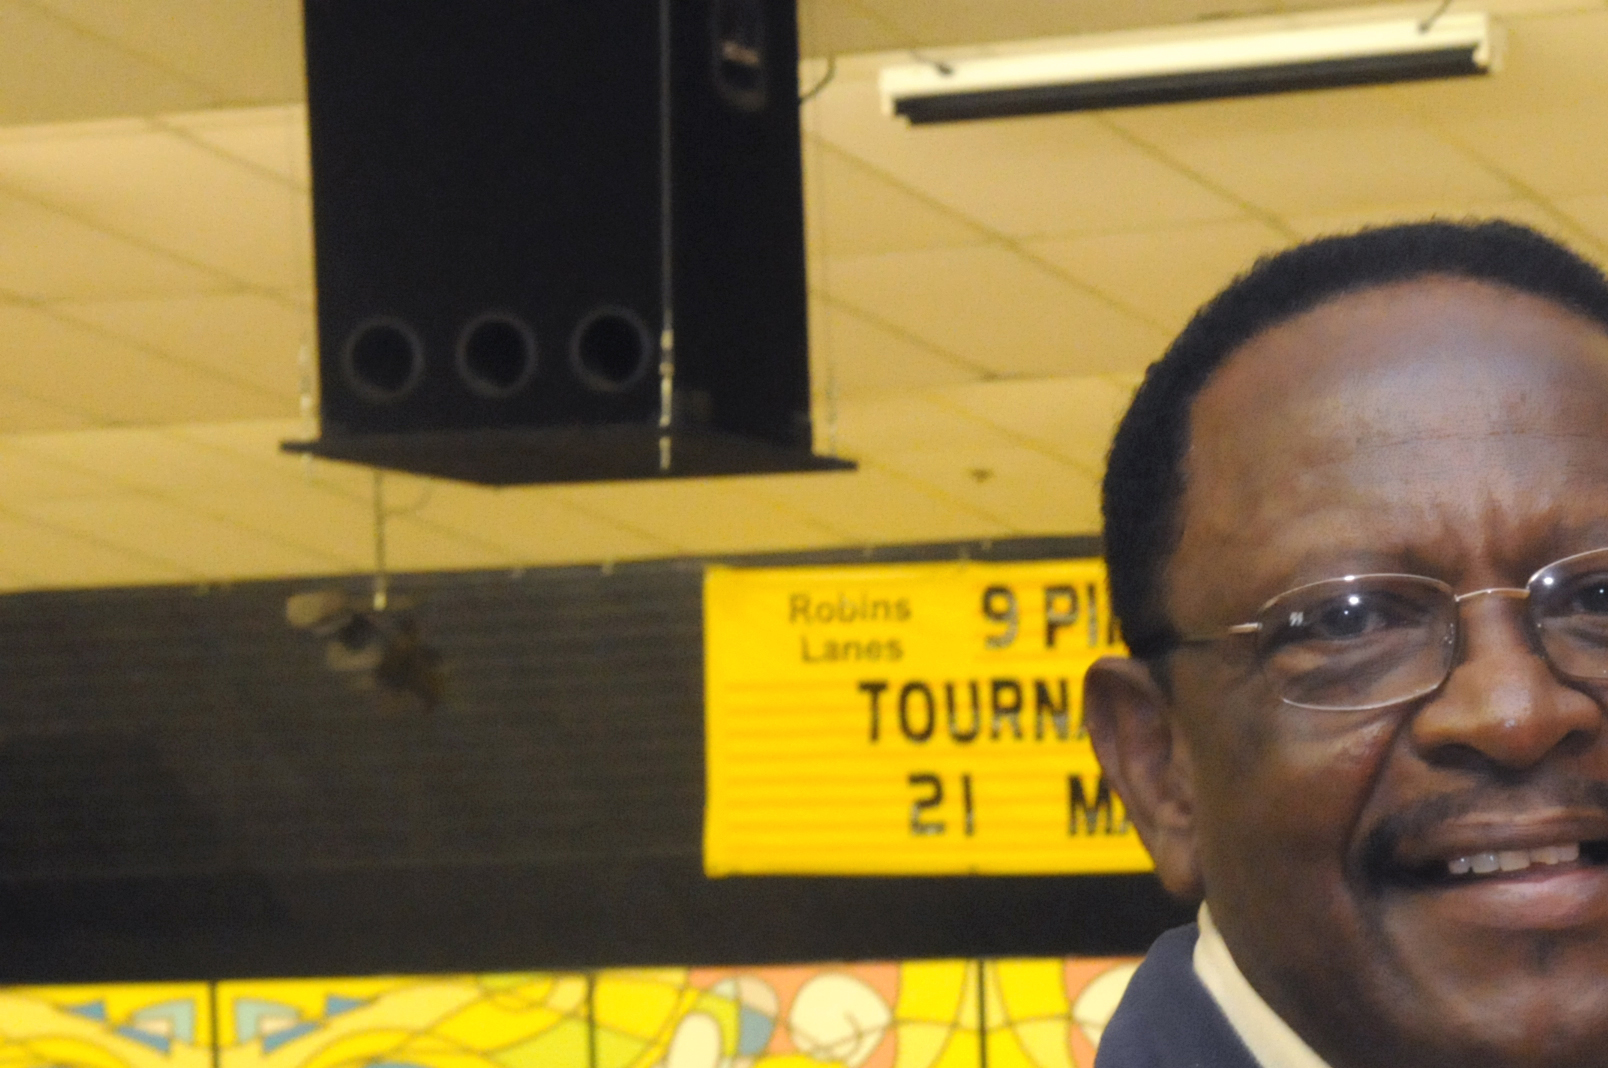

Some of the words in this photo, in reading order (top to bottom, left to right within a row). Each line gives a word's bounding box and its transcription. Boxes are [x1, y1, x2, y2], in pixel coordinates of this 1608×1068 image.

[788, 592, 912, 625] Robins
[981, 582, 1018, 649] 9
[801, 635, 905, 664] Lanes
[857, 678, 1088, 744] TOURN
[907, 773, 976, 838] 21
[1066, 772, 1133, 838] M
